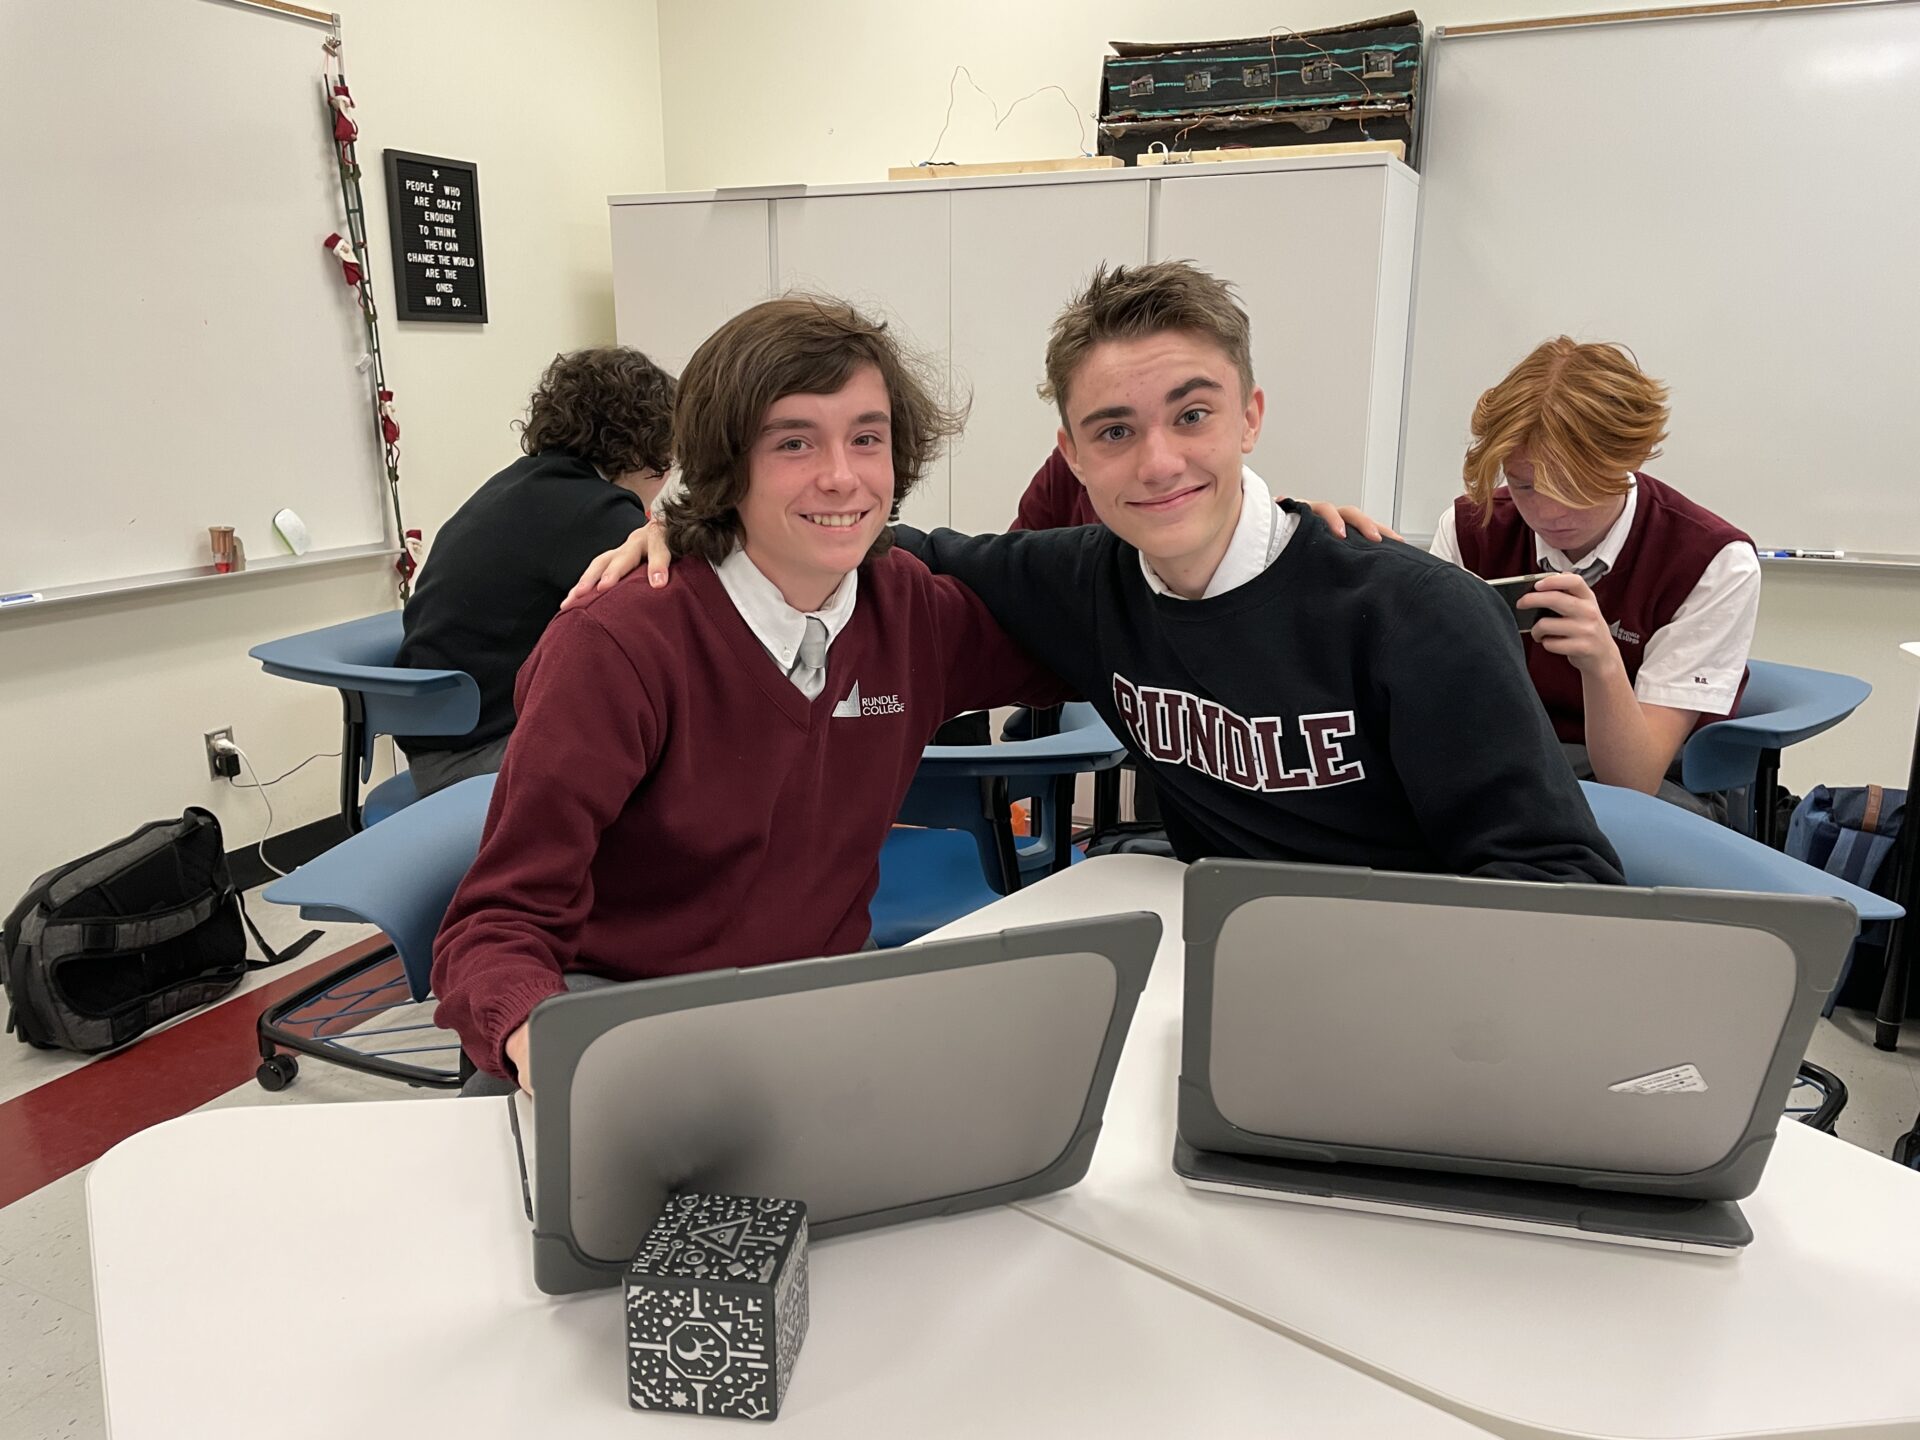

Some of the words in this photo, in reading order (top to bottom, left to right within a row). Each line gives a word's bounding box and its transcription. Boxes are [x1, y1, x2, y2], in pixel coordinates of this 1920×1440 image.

[406, 180, 434, 194] PEOPLE
[444, 186, 460, 196] WHO
[414, 196, 430, 207] ARE
[436, 199, 461, 210] CRAZY
[424, 211, 454, 224] ENOUGH
[418, 224, 429, 236] TO
[434, 226, 456, 238] THINK
[424, 240, 442, 250] THEY
[444, 242, 458, 252] CAN
[407, 252, 435, 264] CHANGE
[438, 255, 450, 266] THE
[452, 256, 475, 268] WORLD
[426, 268, 440, 278] ARE
[444, 270, 458, 280] THE
[436, 283, 454, 293] ONES
[425, 296, 442, 306] WHO
[862, 694, 898, 706] RUNDLE
[862, 703, 905, 716] COLLEGE
[1112, 672, 1366, 792] RUNDLE
